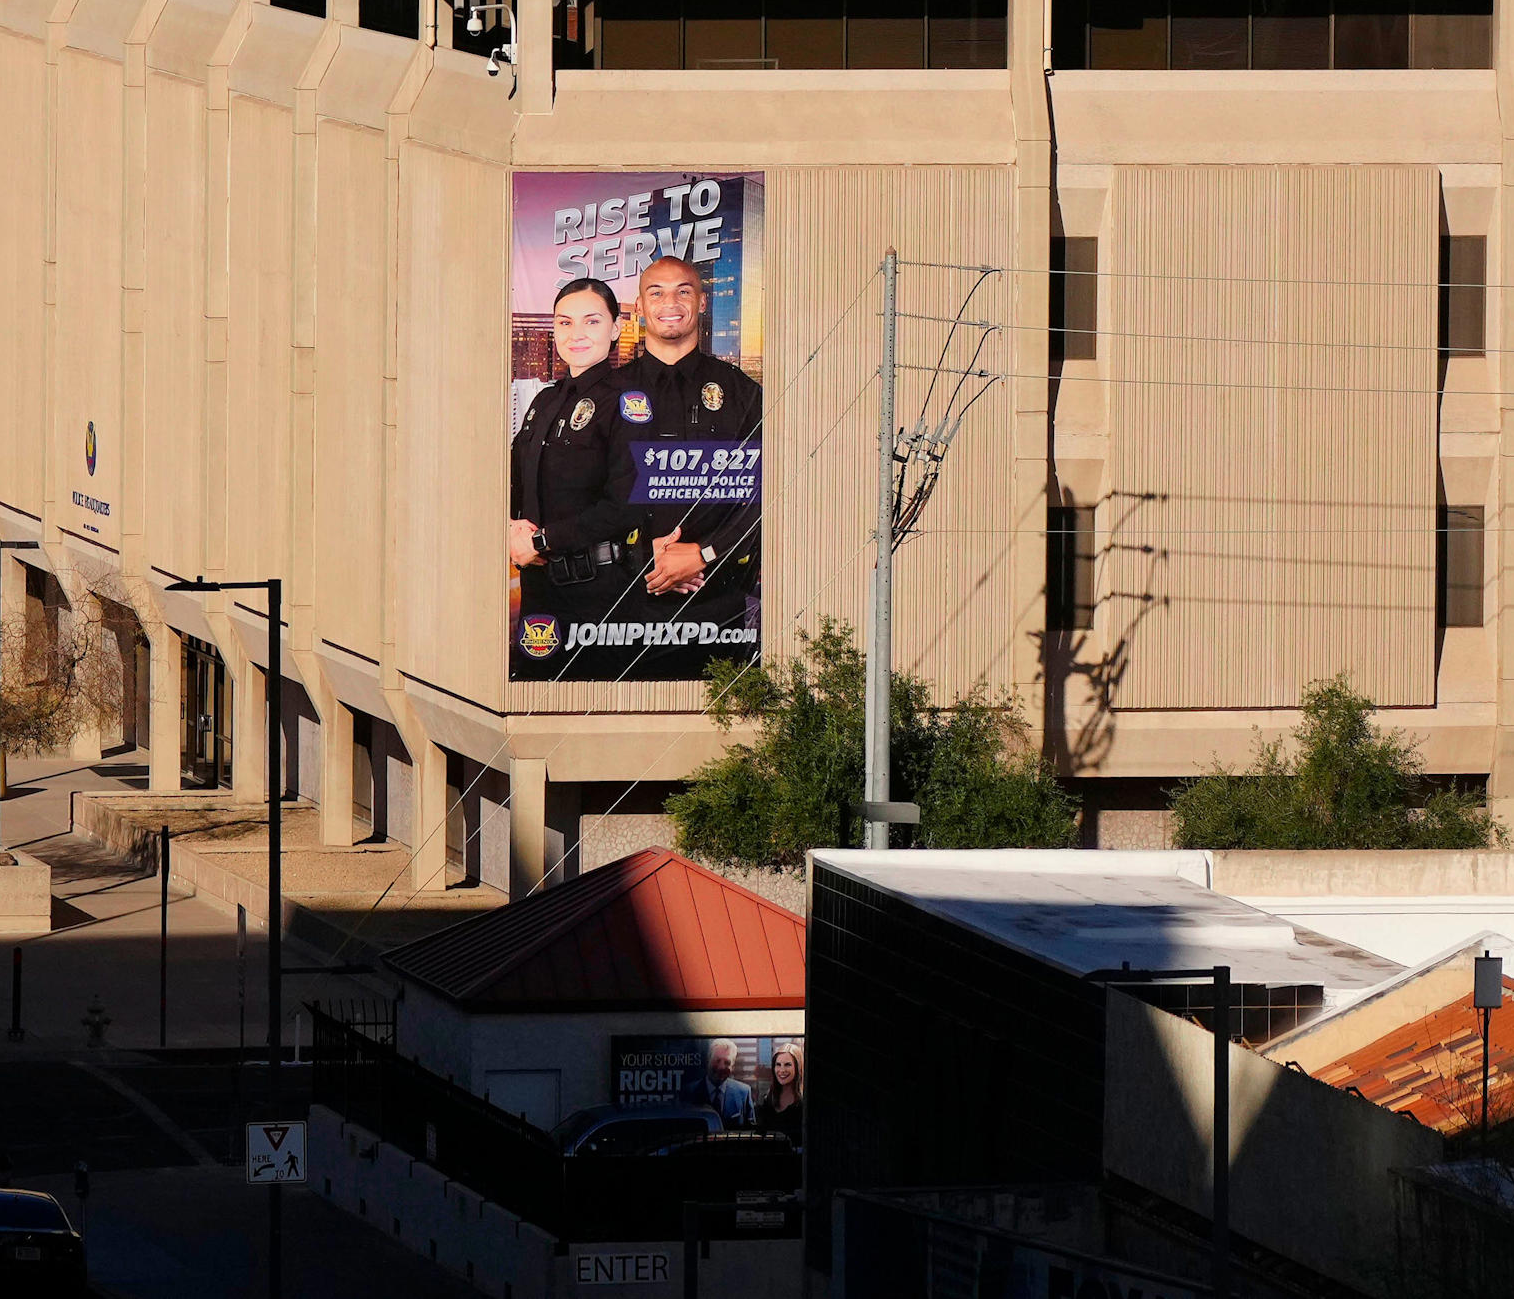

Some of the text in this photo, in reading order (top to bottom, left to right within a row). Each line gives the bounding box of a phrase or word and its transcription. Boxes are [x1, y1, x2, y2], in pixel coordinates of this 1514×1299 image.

[553, 179, 721, 245] RISE TO
[554, 216, 723, 290] SERVE
[644, 447, 761, 475] $107,827
[648, 475, 755, 486] MAXIMUM POLICE
[648, 487, 753, 499] OFFICER SALARY
[620, 1052, 702, 1067] YOUR STORIES
[619, 1069, 684, 1092] RIGHT
[252, 1154, 272, 1163] HERE
[577, 1254, 669, 1282] ENTER
